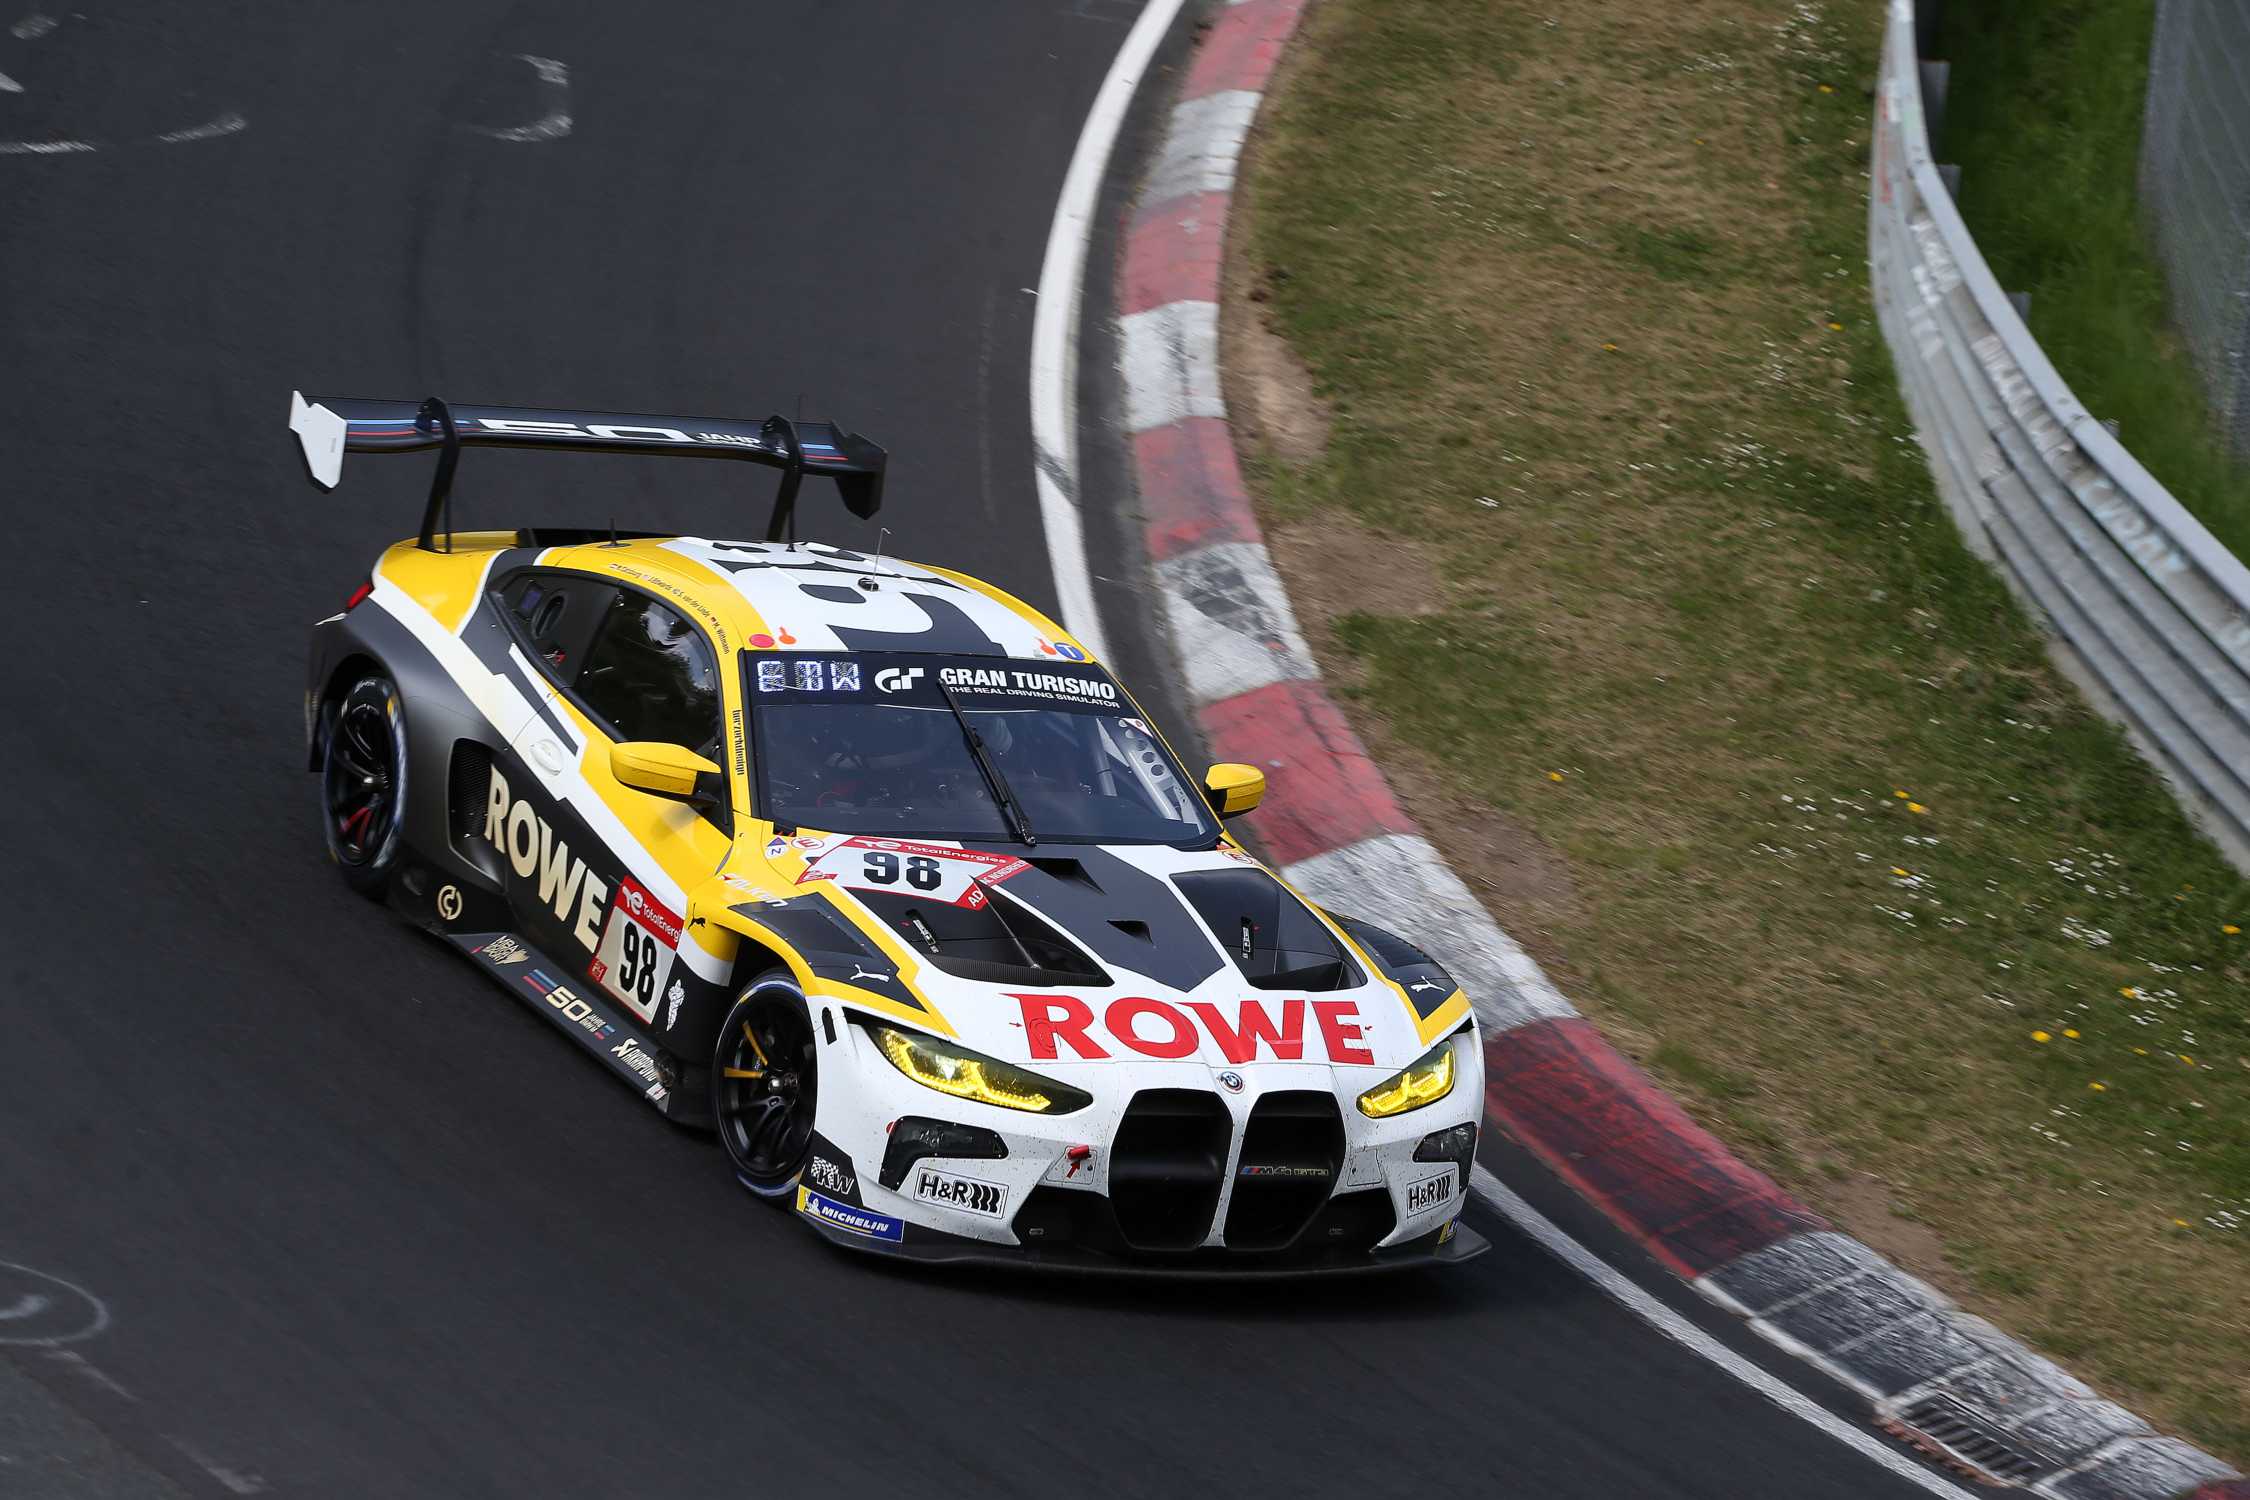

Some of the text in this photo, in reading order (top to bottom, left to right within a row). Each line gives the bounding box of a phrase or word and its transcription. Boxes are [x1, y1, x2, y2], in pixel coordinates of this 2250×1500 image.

[478, 418, 700, 443] 50
[940, 667, 1116, 701] GRAN TURISMO
[949, 686, 1121, 709] THE REAL DRIVING SIMULATOR
[484, 763, 609, 954] ROWE
[863, 851, 942, 892] 98
[905, 844, 1008, 865] TotalEnergies
[619, 921, 657, 1007] 98
[545, 985, 593, 1022] 50
[995, 992, 1375, 1065] ROWE
[815, 1168, 856, 1195] KW
[918, 1172, 970, 1207] H&R
[1408, 1180, 1436, 1212] H&R
[821, 1206, 890, 1232] MICHELIN
